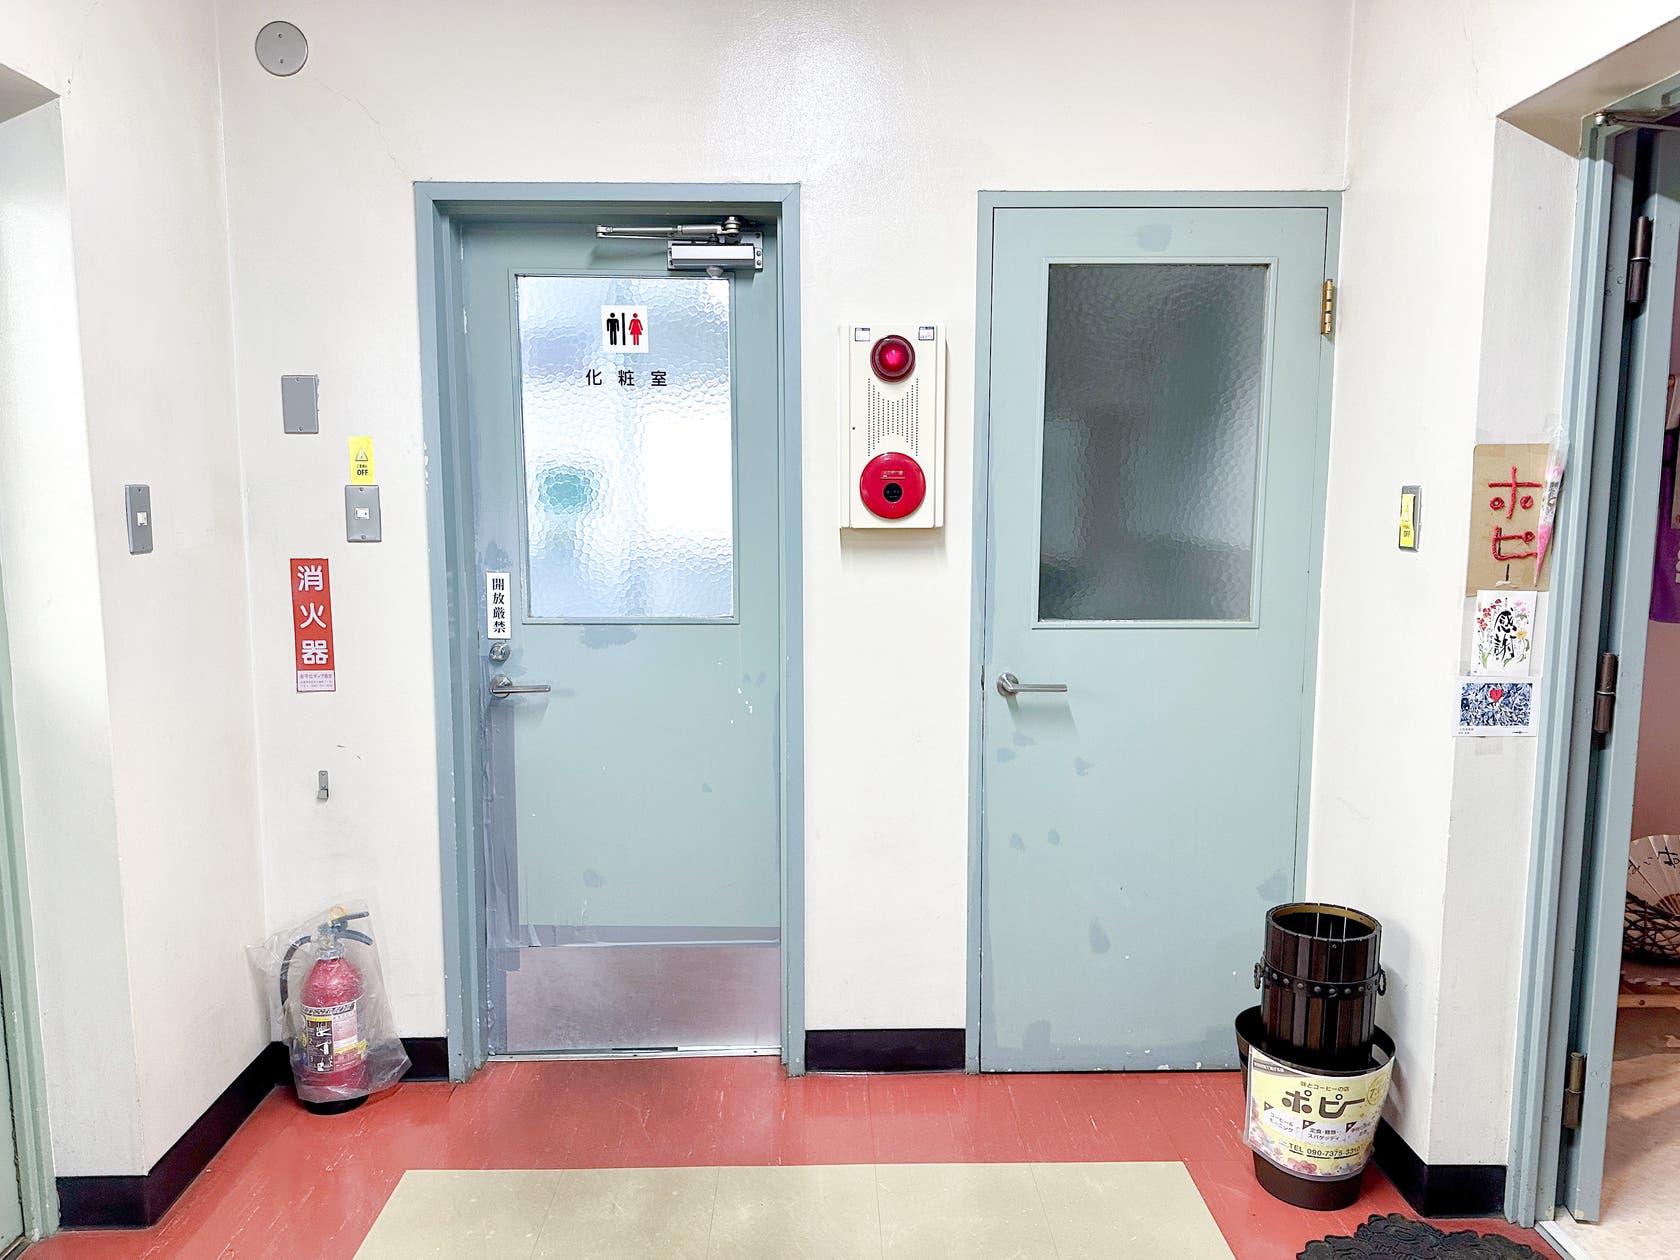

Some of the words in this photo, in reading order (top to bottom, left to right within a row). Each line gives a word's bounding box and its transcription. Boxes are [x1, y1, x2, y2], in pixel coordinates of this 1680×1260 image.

[586, 369, 667, 386] 化粧室
[297, 565, 329, 665] 消火器
[492, 578, 506, 633] 開放厳禁
[1281, 1090, 1365, 1119] ポピー
[1288, 1142, 1304, 1153] TEL
